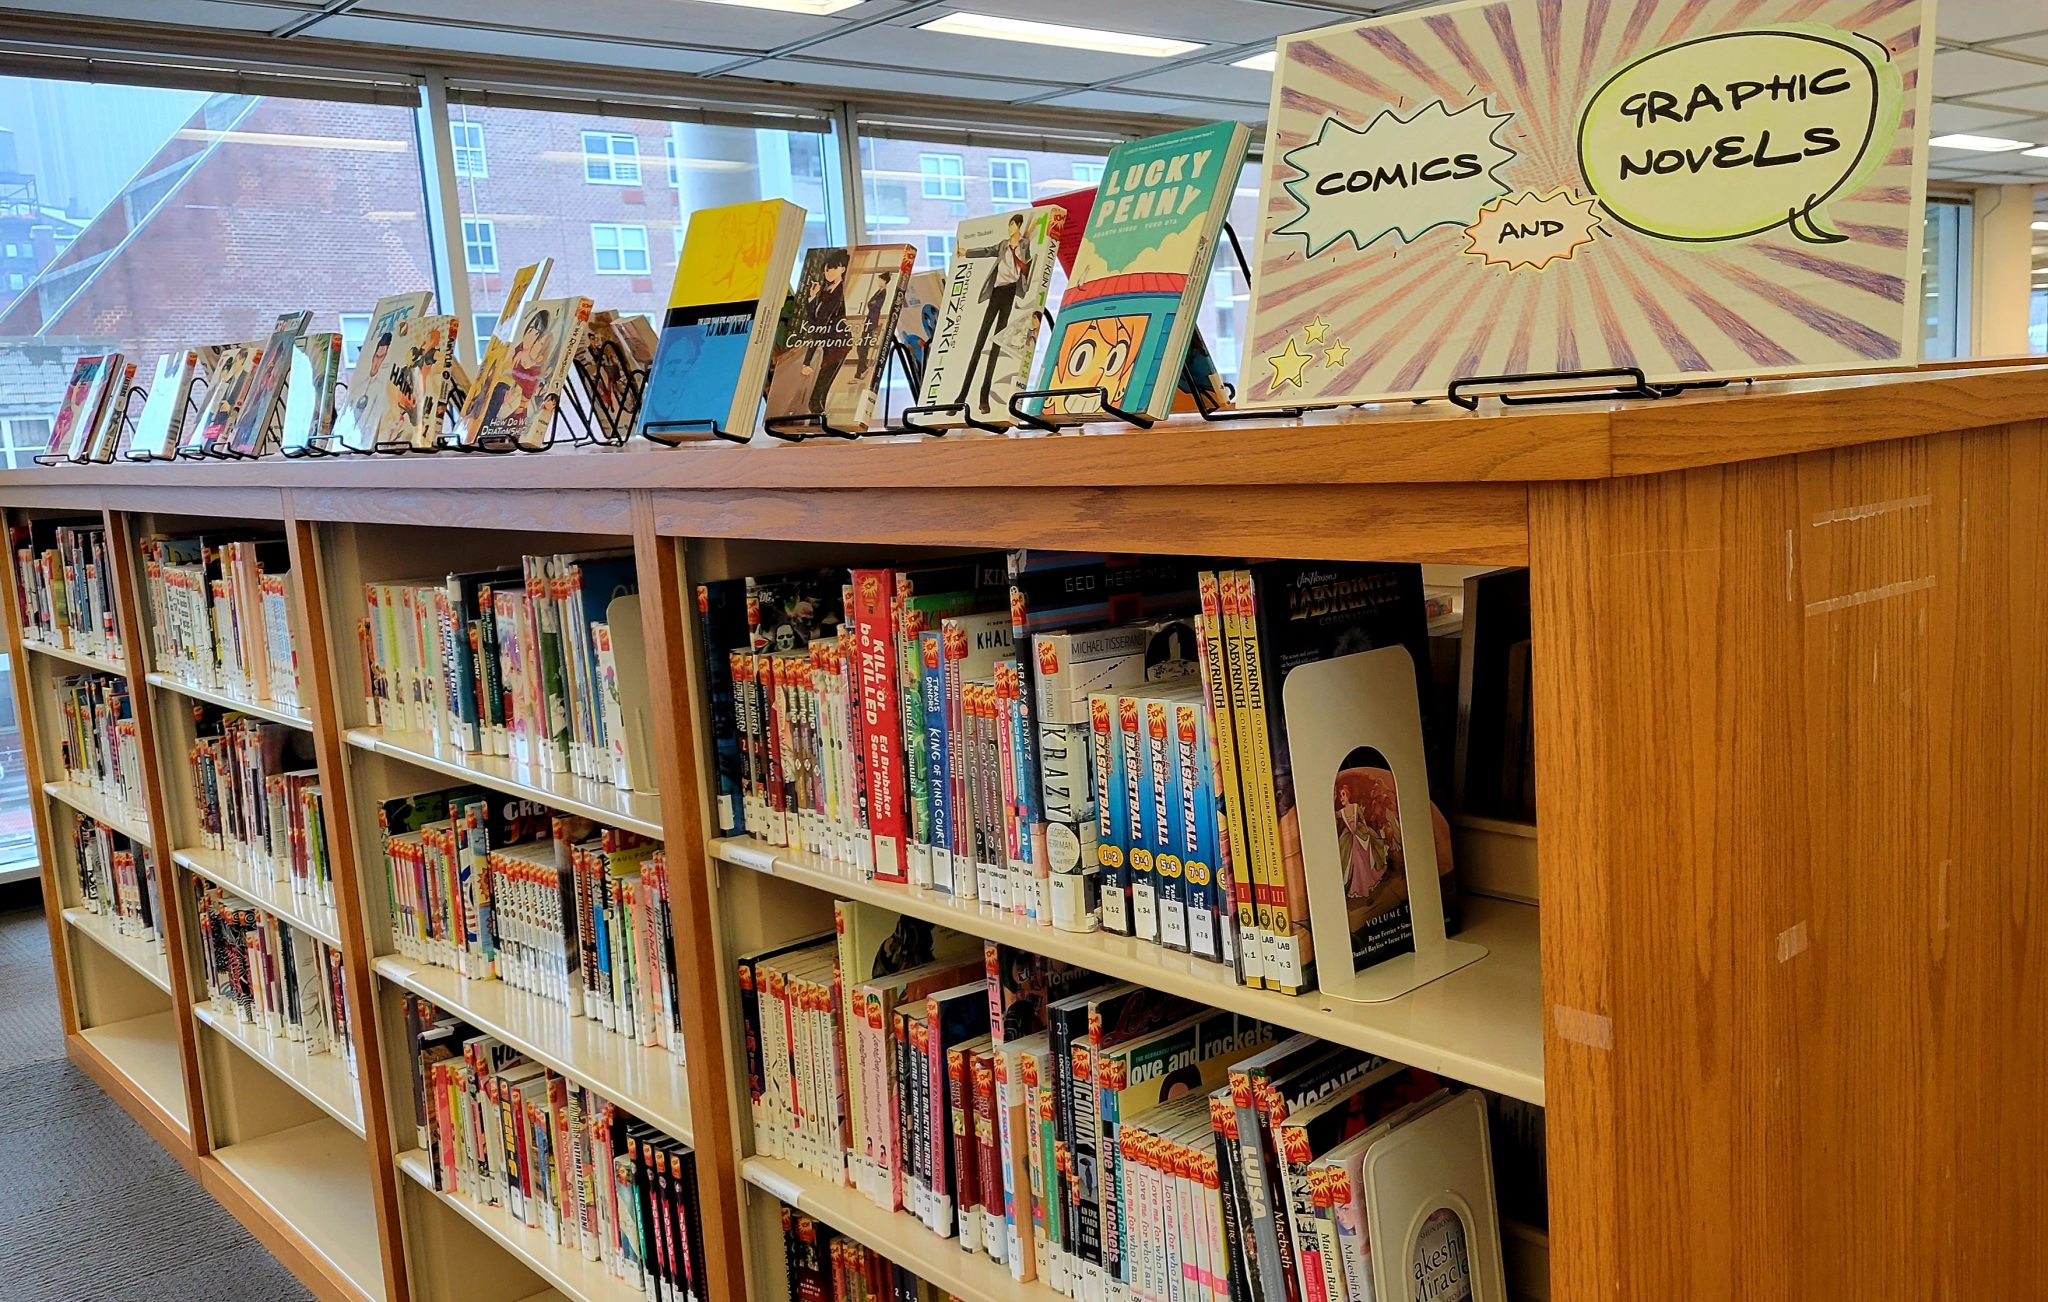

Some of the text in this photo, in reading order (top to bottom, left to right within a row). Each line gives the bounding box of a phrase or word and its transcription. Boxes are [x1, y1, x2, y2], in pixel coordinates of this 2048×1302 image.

[1620, 67, 1851, 127] GRAPHIC
[1620, 126, 1842, 181] NOVELS
[1106, 149, 1213, 196] LUCKY
[1315, 152, 1484, 196] COMICS
[1095, 184, 1201, 228] PENNY
[1037, 212, 1049, 245] 1
[1498, 219, 1565, 243] AND
[958, 262, 974, 312] MONTHLY
[786, 334, 878, 349] Communicate
[800, 319, 832, 334] Komi
[1064, 575, 1095, 592] GEO
[1286, 571, 1399, 620] LABYRINTH
[976, 628, 1016, 650] KHAL
[1071, 632, 1146, 655] MICHAEL TISSERAND
[473, 653, 481, 680] FUNNY
[860, 622, 878, 725] be KILLED
[873, 639, 886, 711] KILL or
[932, 676, 941, 713] TRAVIS
[1017, 662, 1032, 760] KRAZY IGNATZ
[1207, 635, 1231, 772] LABYRINTH CORONATION
[1228, 635, 1251, 772] LABYRINTH CORONATION
[1244, 635, 1267, 774] LABYRINTH CORONATION
[870, 733, 883, 820] Sean Phillips
[879, 734, 892, 818] Ed Brubaker
[927, 727, 945, 848] KING OF KING COURT
[1041, 725, 1071, 823] KRAZY
[1095, 733, 1111, 836] BASKETBALL
[1124, 734, 1142, 840] BASKETBALL
[1150, 737, 1169, 846] BASKETBALL
[1179, 741, 1198, 853] BASKETBALL
[976, 832, 982, 845] 2
[988, 836, 995, 849] 3
[1021, 833, 1028, 845] 2
[1240, 887, 1246, 899] I
[1257, 888, 1266, 902] II
[1271, 890, 1285, 904] III
[1366, 908, 1400, 927] VOLUME
[1242, 932, 1255, 941] LAB
[1261, 935, 1274, 944] LAB
[1277, 941, 1290, 951] LAB
[1352, 947, 1368, 958] Daniel
[990, 1000, 1001, 1032] LIE
[1056, 1022, 1063, 1035] 2
[1168, 1024, 1200, 1070] and
[1205, 1013, 1273, 1060] rockets
[1231, 1078, 1247, 1089] POW!
[912, 1087, 920, 1127] GALACTIC
[922, 1095, 930, 1136] GALACTIC
[1000, 1106, 1009, 1145] LESSONS
[1028, 1108, 1037, 1148] LESSONS
[1286, 1131, 1304, 1143] POW!
[573, 1141, 583, 1180] ULTIMATE
[1279, 1148, 1288, 1177] MAGNETO
[1330, 1171, 1347, 1183] POW!
[1126, 1168, 1135, 1196] Love
[1139, 1173, 1148, 1200] Love
[1151, 1178, 1160, 1206] Love
[1243, 1145, 1267, 1219] LUISA
[1310, 1174, 1328, 1187] POW!
[577, 1180, 589, 1233] COLLECTION
[1102, 1136, 1119, 1263] love and rockets
[1164, 1184, 1174, 1214] Love
[1117, 1203, 1126, 1262] rockets
[1128, 1213, 1137, 1231] for
[1142, 1218, 1150, 1236] for
[1154, 1223, 1162, 1242] for
[1082, 1235, 1099, 1248] TRUTH
[1168, 1231, 1176, 1250] for
[1274, 1211, 1293, 1269] Macbeth
[1320, 1233, 1333, 1272] Maiden
[1414, 1231, 1461, 1280] akeshi
[1086, 1268, 1097, 1277] LOG
[1344, 1243, 1358, 1291] Makeshift
[894, 1287, 900, 1297] 2
